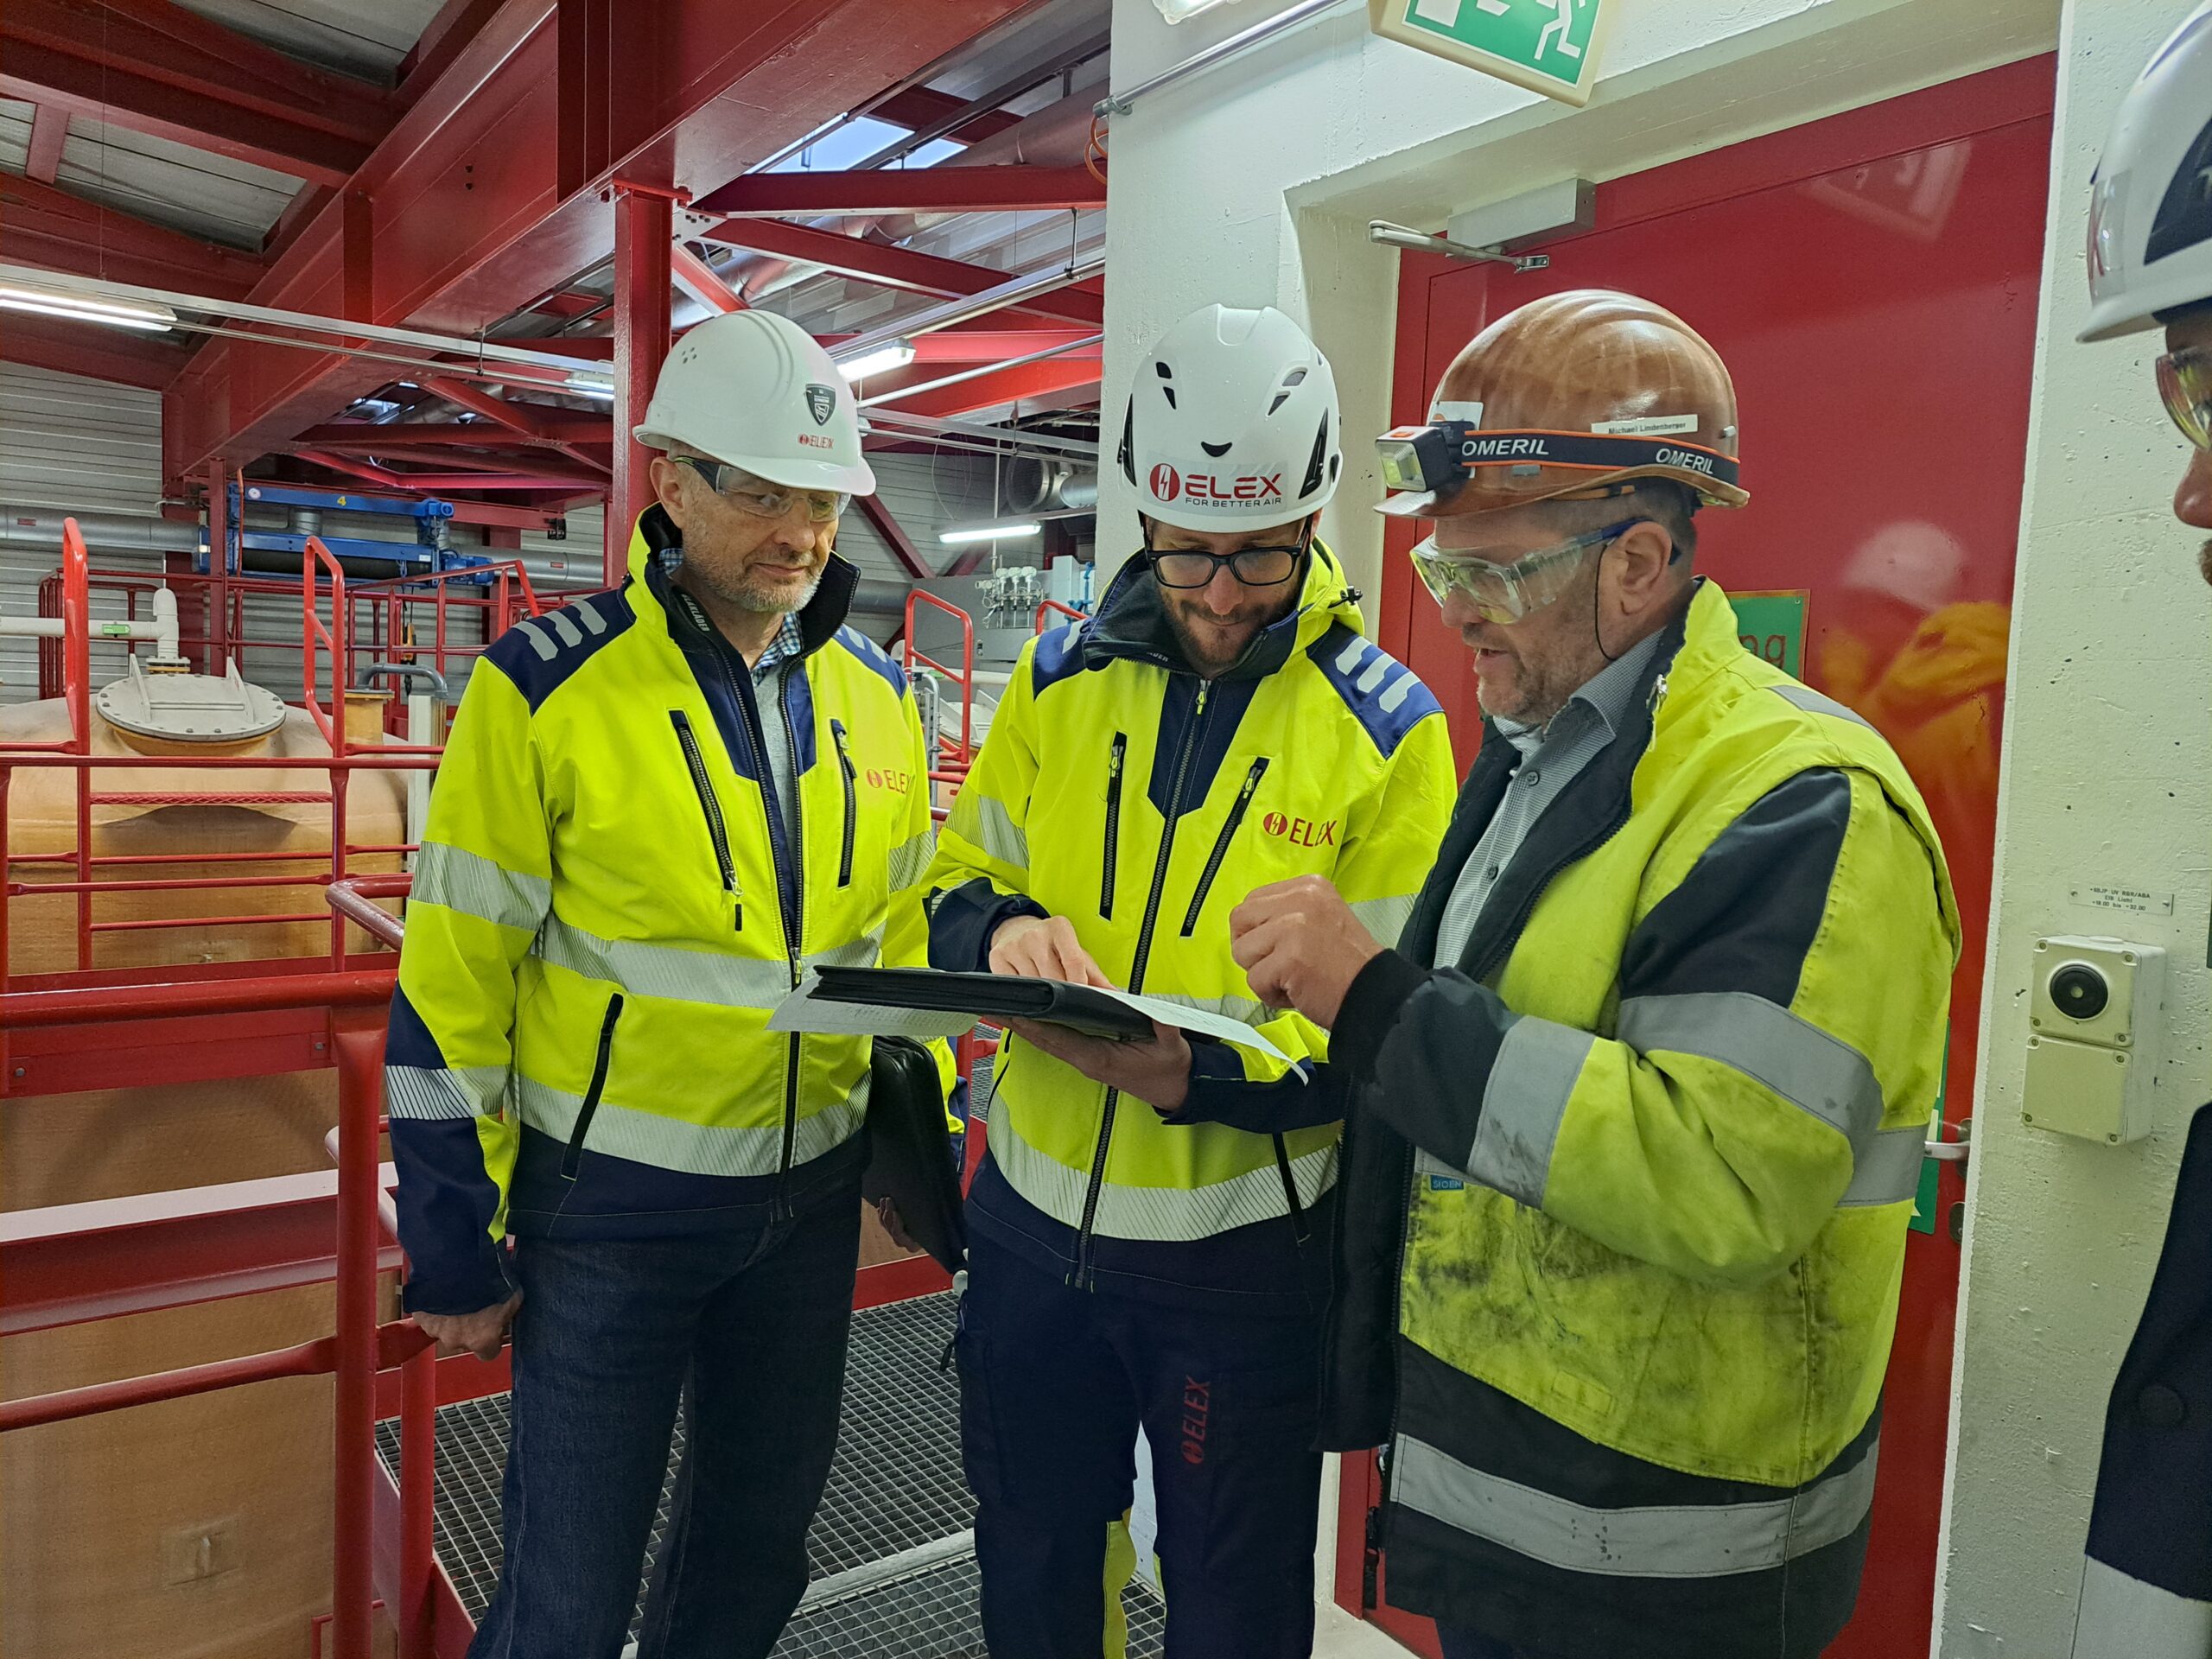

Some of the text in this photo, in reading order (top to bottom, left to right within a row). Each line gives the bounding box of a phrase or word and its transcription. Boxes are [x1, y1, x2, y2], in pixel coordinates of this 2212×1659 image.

[1608, 422, 1687, 435] Michael Lindenberger
[809, 434, 835, 449] ELEX
[1461, 439, 1715, 475] OMERIL OMERIL
[1185, 473, 1282, 499] ELEX
[337, 495, 346, 506] 4
[1185, 497, 1282, 508] FOR BETTER AIR
[882, 769, 916, 795] ELEX
[1433, 1179, 1463, 1190] SIOEN
[1181, 1374, 1211, 1442] ELEX
